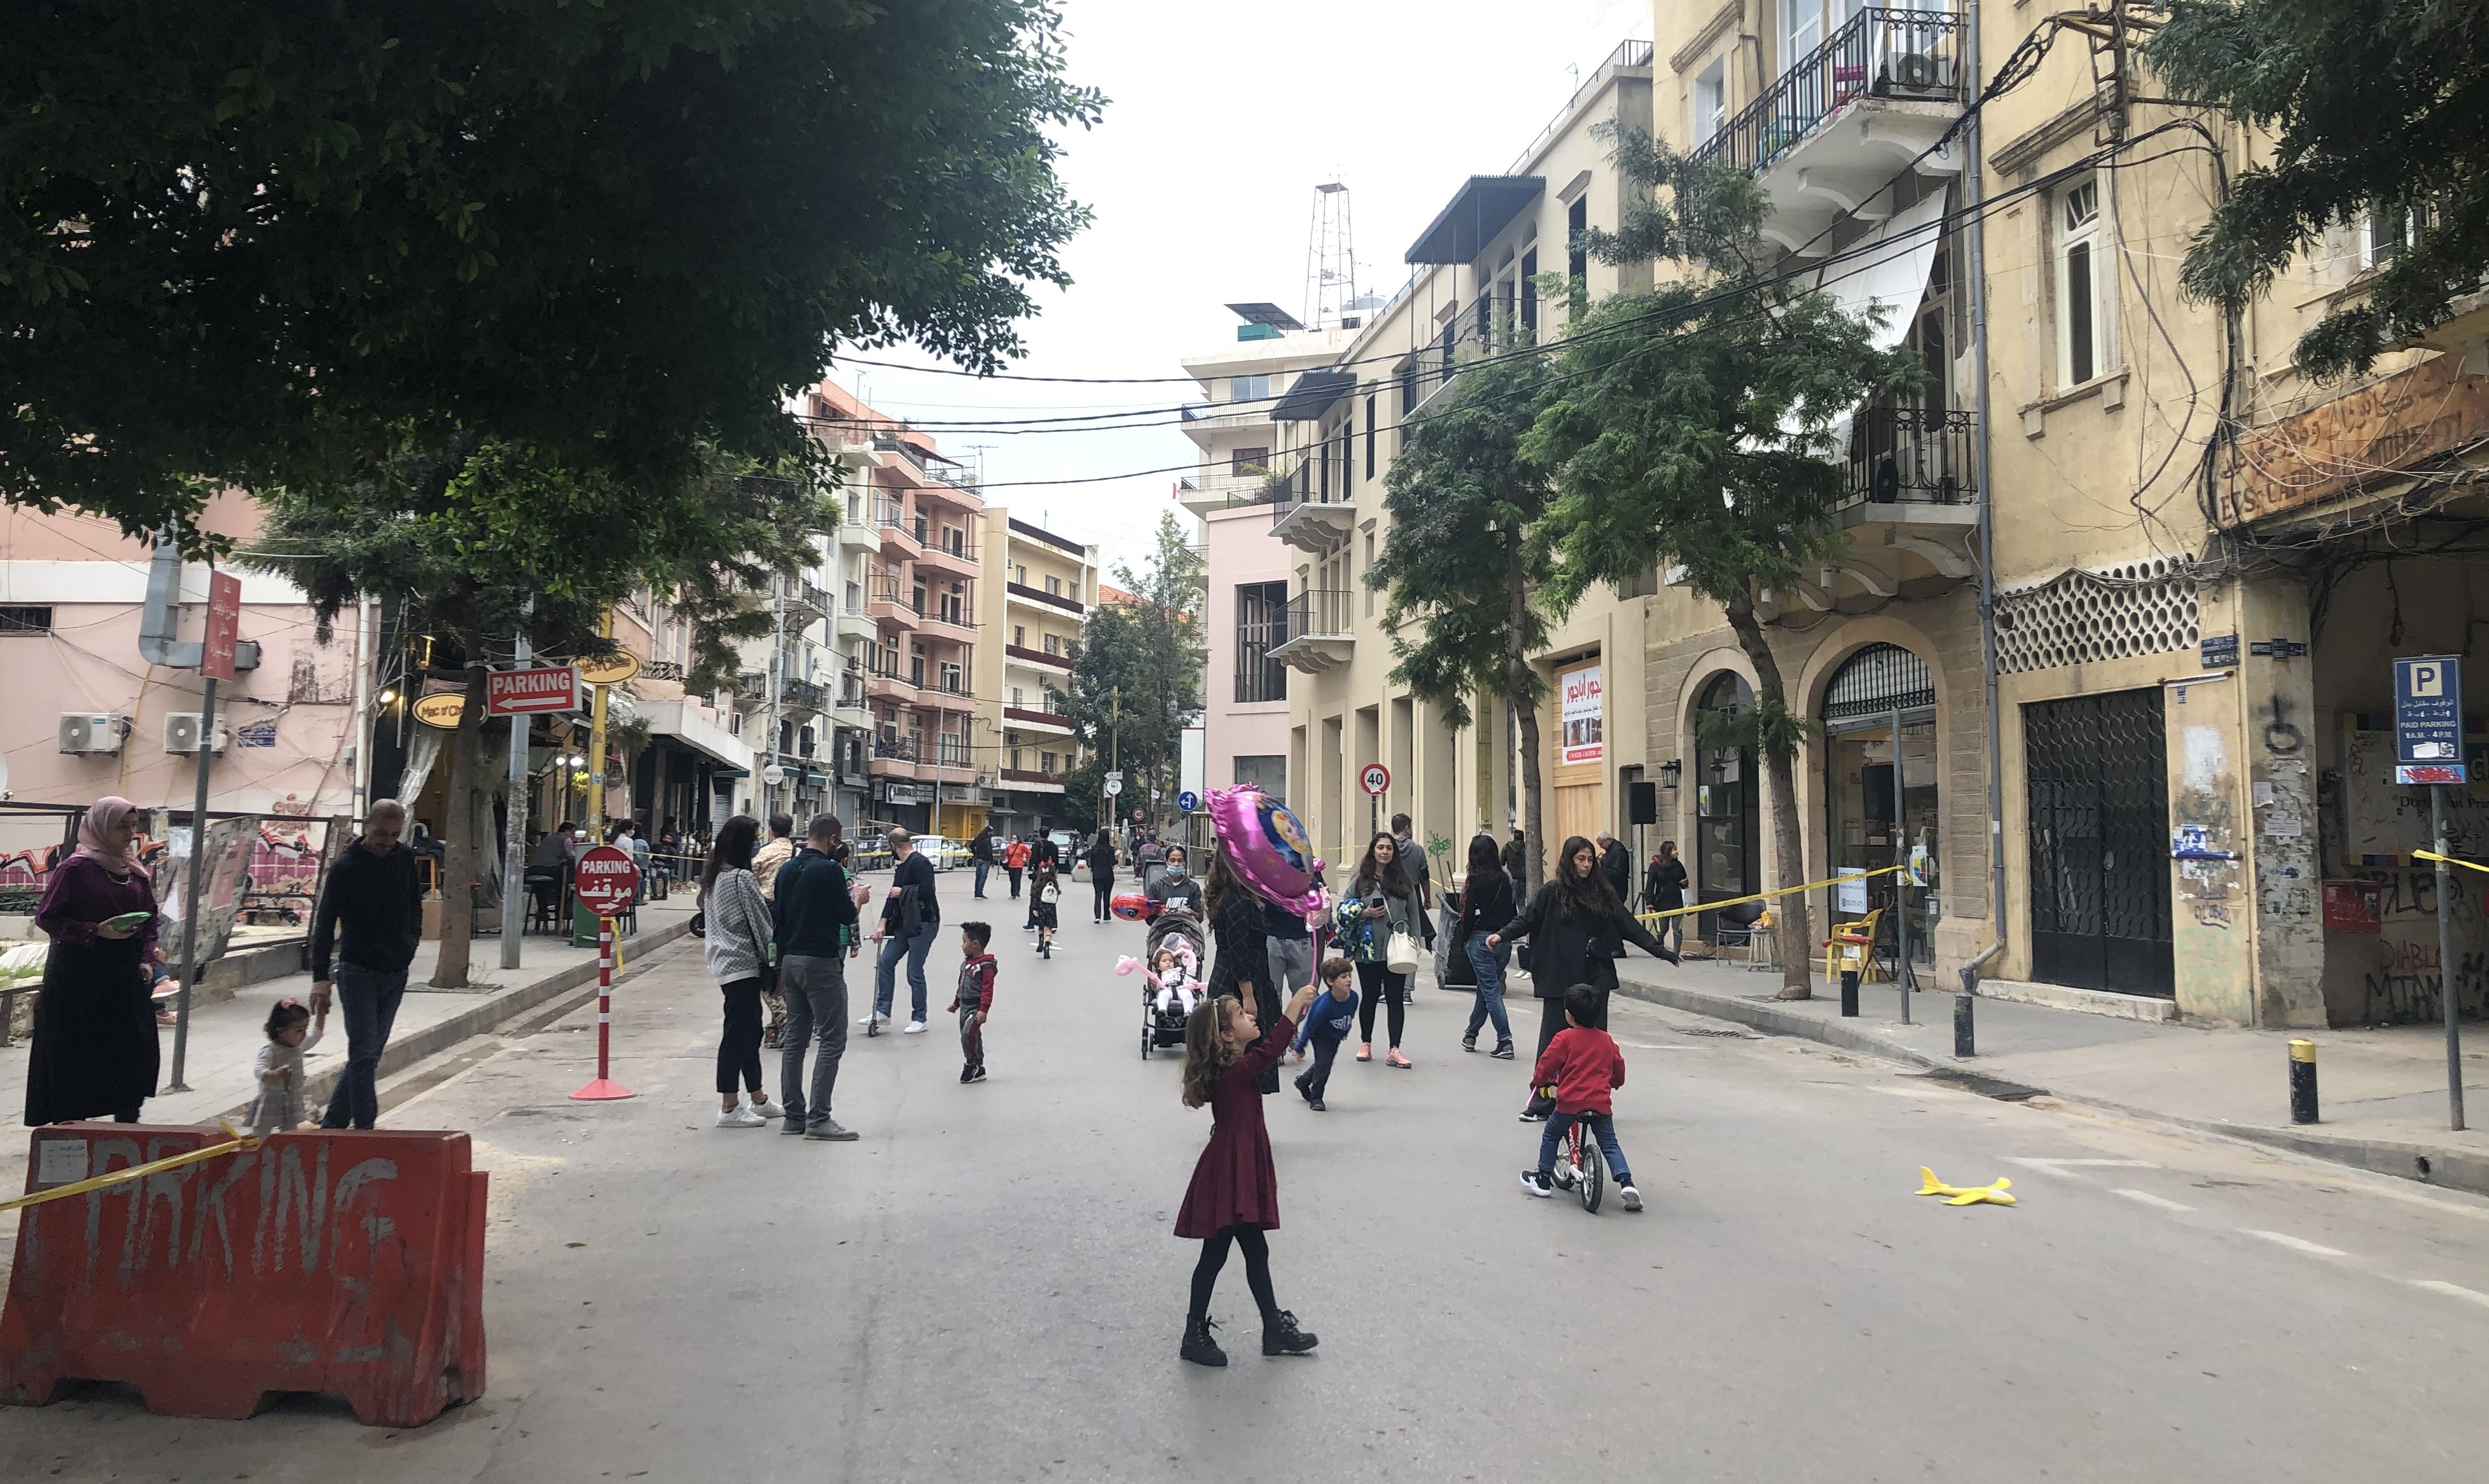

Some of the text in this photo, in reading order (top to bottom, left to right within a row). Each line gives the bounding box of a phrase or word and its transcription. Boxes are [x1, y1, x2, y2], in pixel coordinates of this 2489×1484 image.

[492, 672, 571, 695] PARKING
[2416, 667, 2435, 691] P
[1367, 773, 1383, 785] 40
[581, 860, 631, 874] PARKING
[579, 878, 632, 903] موقف
[1165, 897, 1189, 908] NIKE
